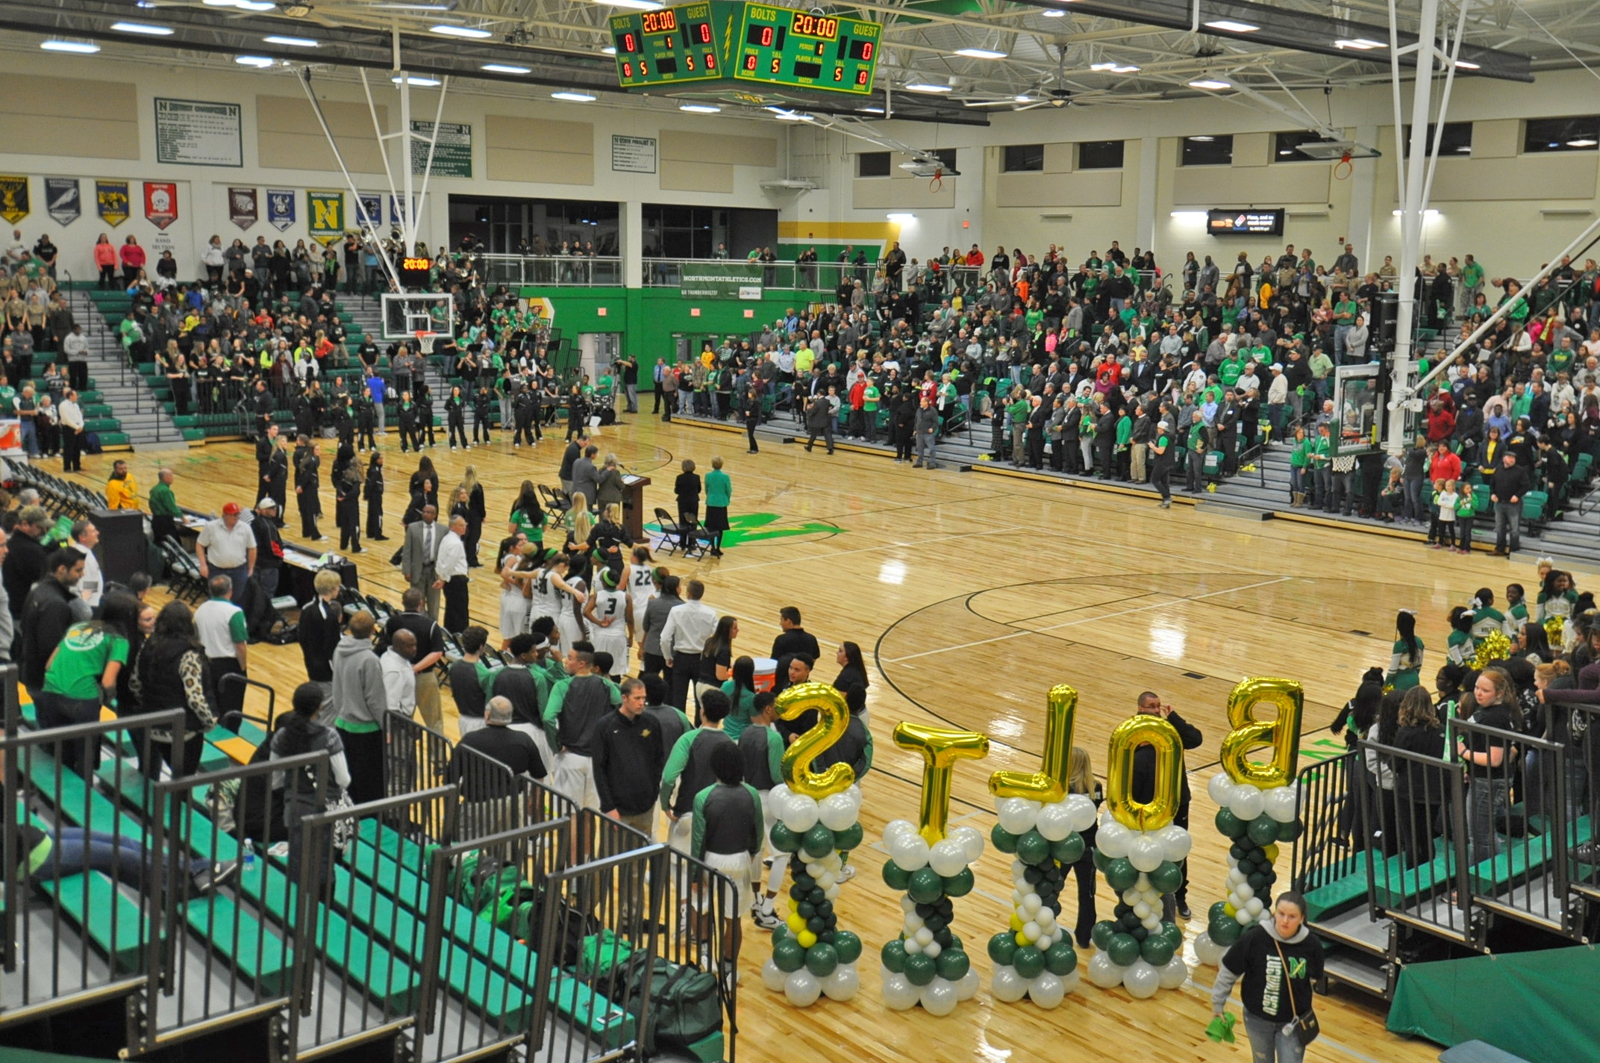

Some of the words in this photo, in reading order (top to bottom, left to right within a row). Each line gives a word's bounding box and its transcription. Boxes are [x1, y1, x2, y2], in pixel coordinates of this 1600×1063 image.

[687, 6, 707, 19] GUEST
[750, 7, 776, 21] BOLTS
[613, 18, 631, 29] BOLTS
[643, 10, 675, 32] 20:00
[793, 14, 836, 37] 20:00
[700, 23, 711, 43] 0
[761, 27, 773, 46] 0
[854, 24, 878, 37] GUEST
[625, 33, 635, 52] 0
[799, 43, 814, 51] PERIOD
[818, 43, 824, 55] 1
[744, 47, 759, 55] FOULS
[862, 42, 873, 60] 0
[640, 61, 647, 75] 5
[686, 56, 694, 71] 5
[706, 53, 715, 69] 0
[747, 56, 756, 70] 0
[772, 59, 779, 73] 5
[624, 62, 632, 77] 0
[835, 67, 842, 81] 5
[858, 71, 868, 84] 0
[159, 102, 168, 111] N
[228, 107, 237, 116] N
[462, 125, 469, 134] N
[312, 199, 339, 229] N
[403, 258, 428, 270] 20:00
[683, 275, 762, 283] NORTHMONTATHLETICS.COM
[634, 570, 652, 587] 22
[604, 597, 617, 615] 3
[1288, 956, 1307, 979] N
